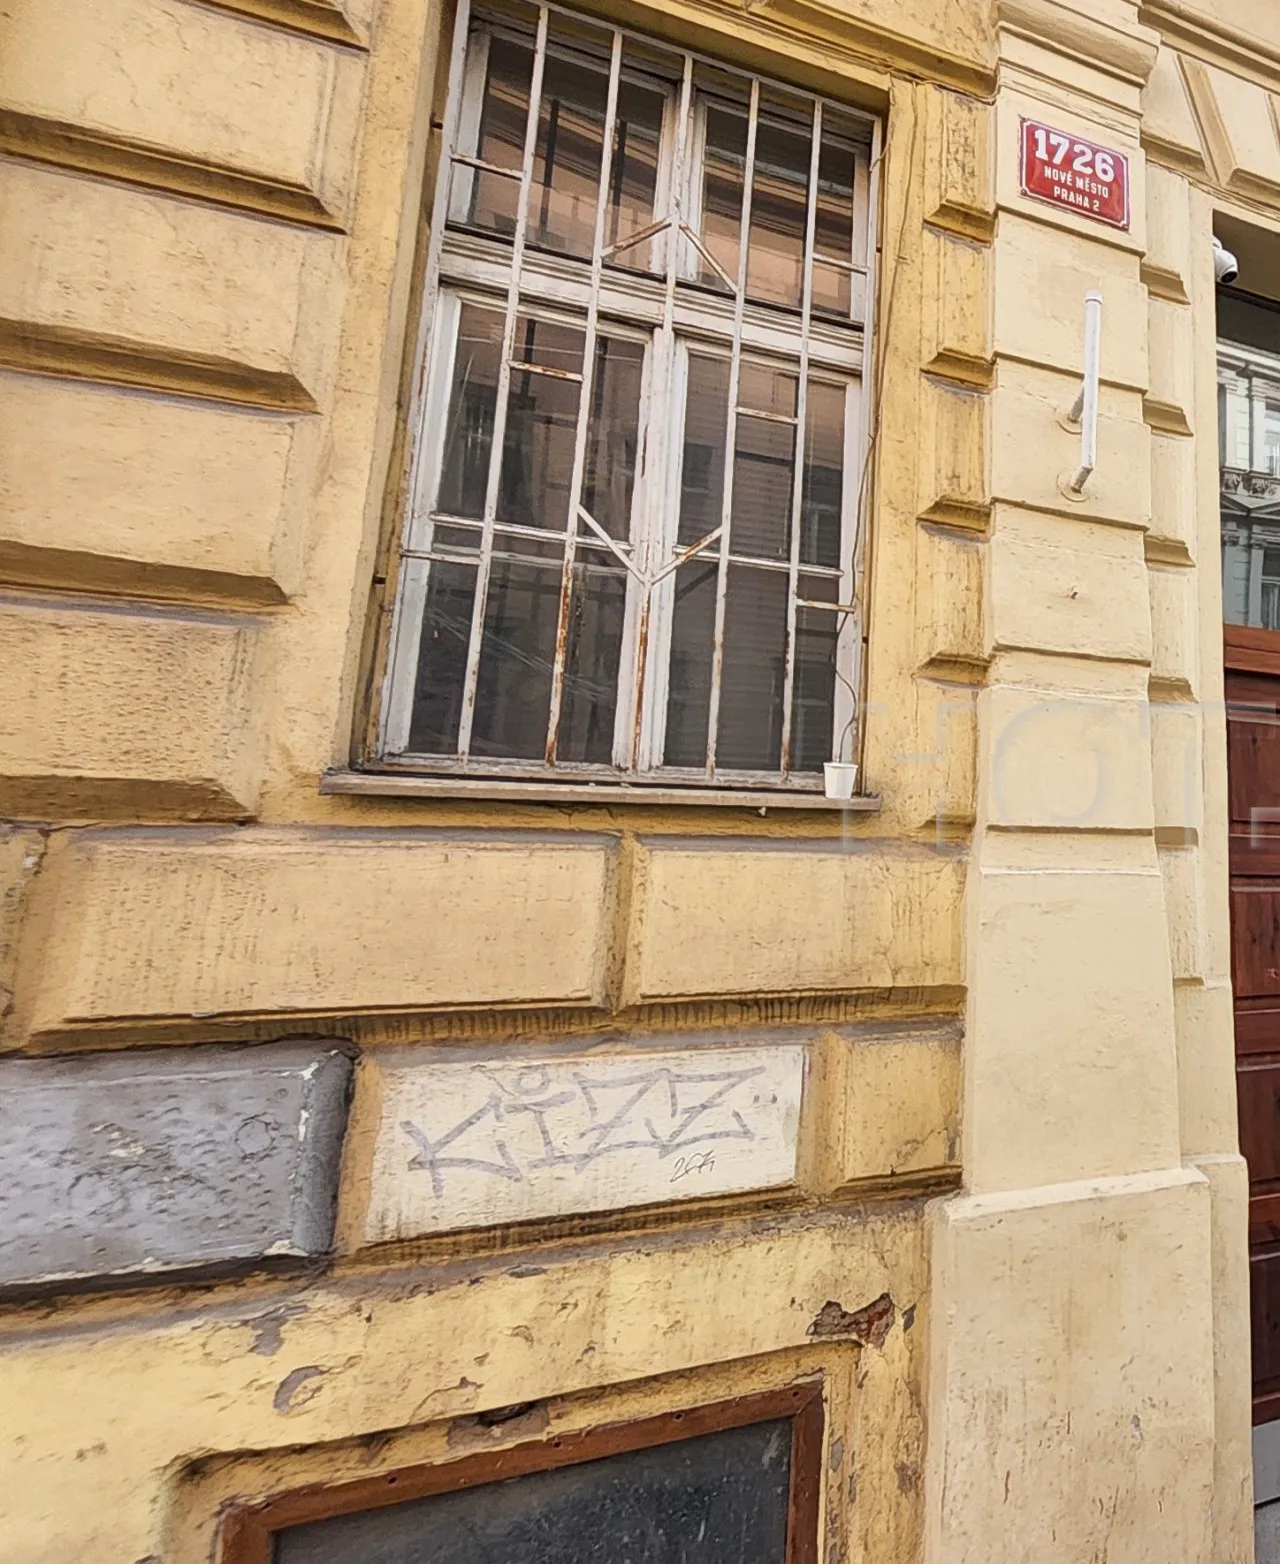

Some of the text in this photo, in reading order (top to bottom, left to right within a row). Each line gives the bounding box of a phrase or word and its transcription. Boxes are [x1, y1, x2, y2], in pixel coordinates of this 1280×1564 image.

[1034, 129, 1115, 182] 1726
[1044, 166, 1073, 186] NOVÉ
[1053, 186, 1100, 212] PRAHA 2
